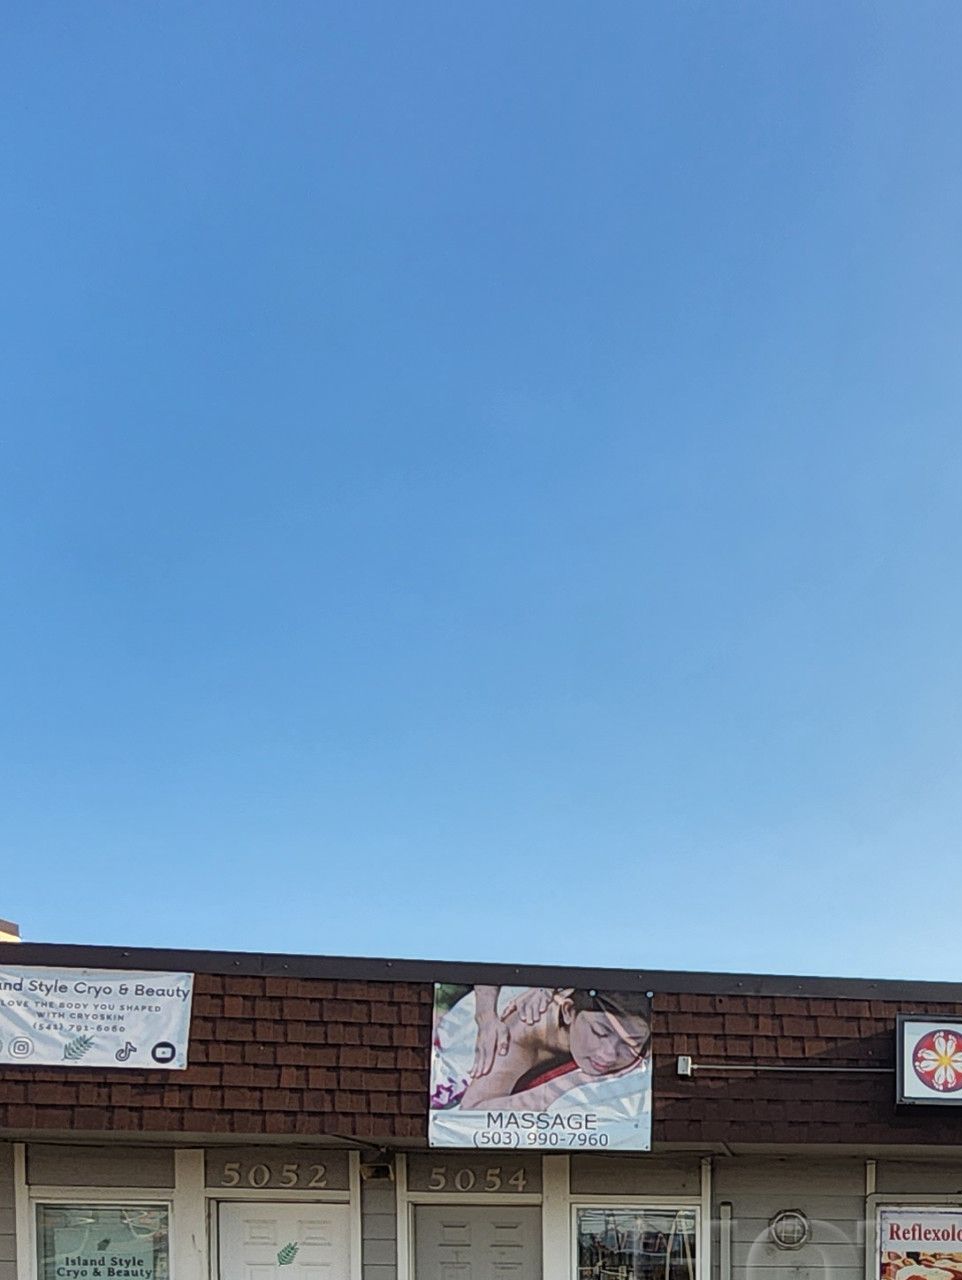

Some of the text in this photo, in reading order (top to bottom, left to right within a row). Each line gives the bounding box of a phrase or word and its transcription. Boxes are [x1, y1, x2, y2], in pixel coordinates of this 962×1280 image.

[0, 978, 190, 1001] nd Style Cryo & Beauty
[0, 1000, 161, 1013] LOVE THE BODY YOU SHAPED
[36, 1012, 125, 1021] WITH CRYOSKIN
[486, 1112, 598, 1131] MASSAGE
[472, 1131, 609, 1148] (503) 990-7960
[221, 1162, 327, 1188] 5052
[428, 1165, 528, 1192] 5054
[65, 1256, 144, 1268] Island Style
[56, 1267, 153, 1279] Cryo & Beauty
